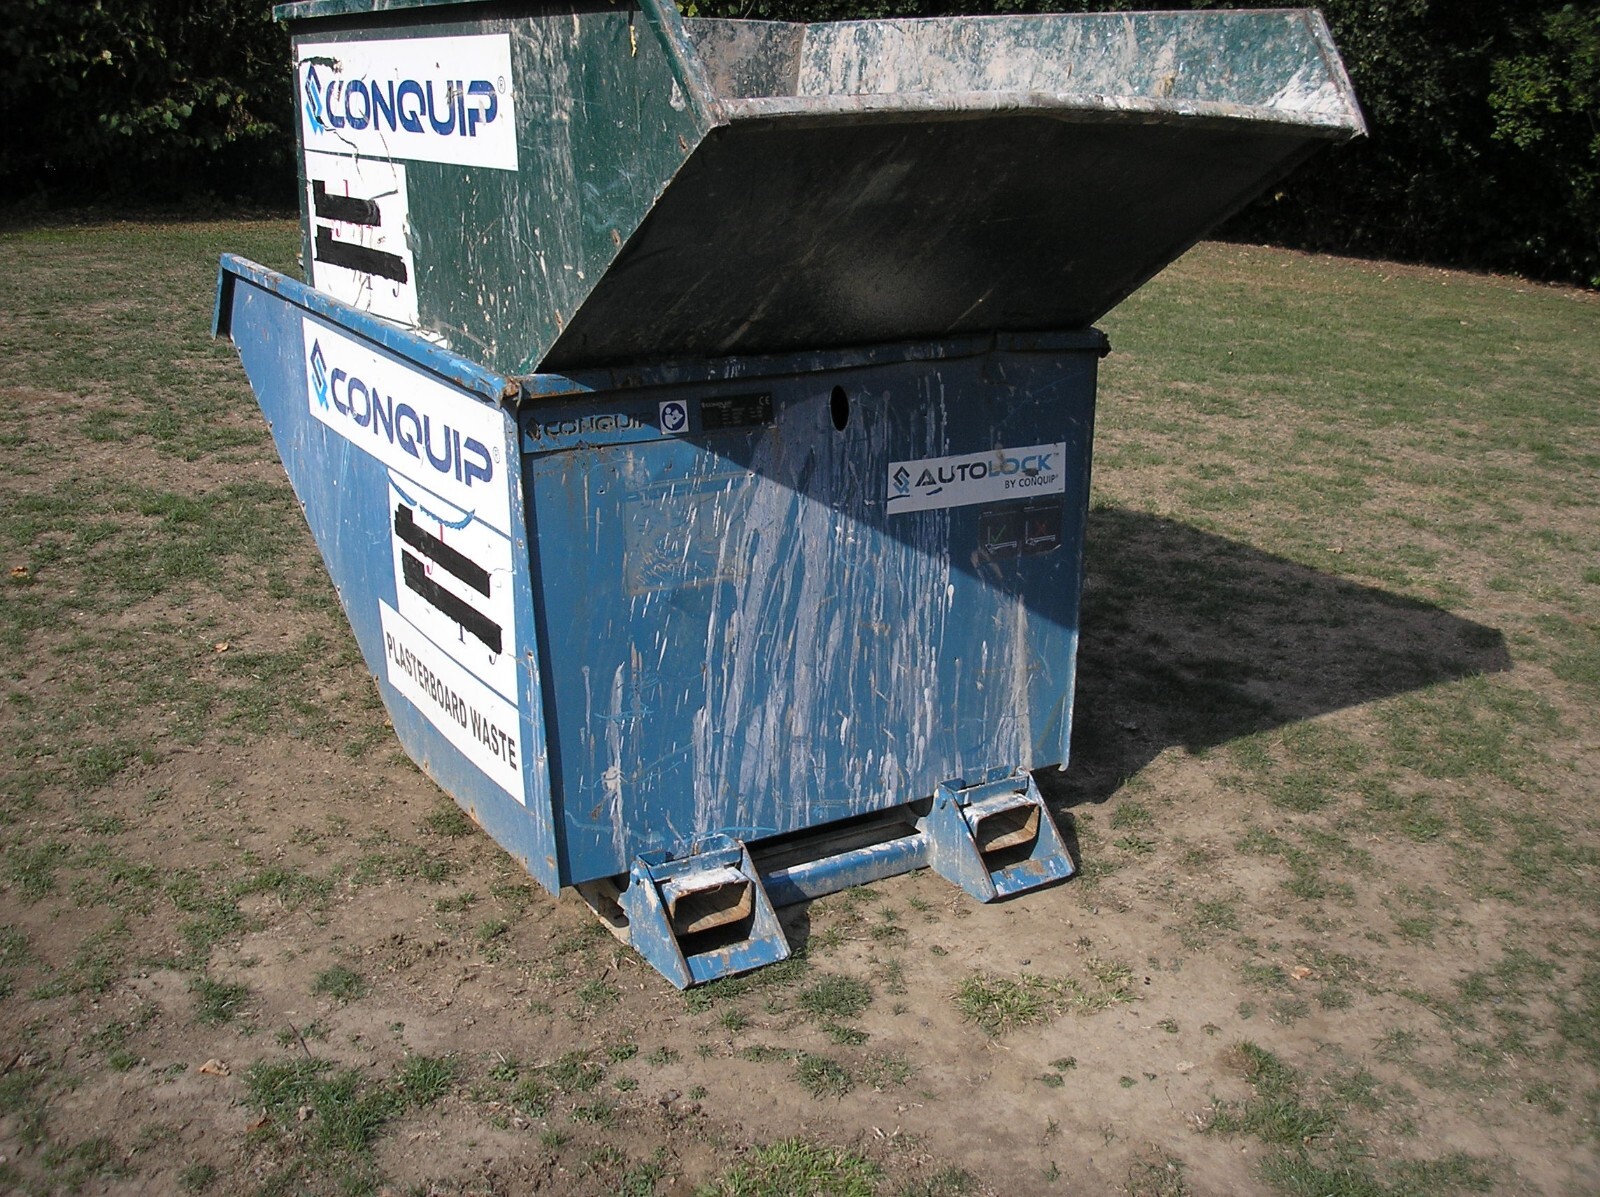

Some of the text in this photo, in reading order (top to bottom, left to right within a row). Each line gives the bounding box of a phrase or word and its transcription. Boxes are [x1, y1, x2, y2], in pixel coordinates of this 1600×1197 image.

[325, 79, 499, 138] CONQUIP
[330, 367, 494, 488] CONQUIP
[914, 452, 1053, 488] AUTOLOCK
[1004, 475, 1056, 490] BY CONQUIP
[385, 631, 518, 771] PLASTERBOARD WASTE
